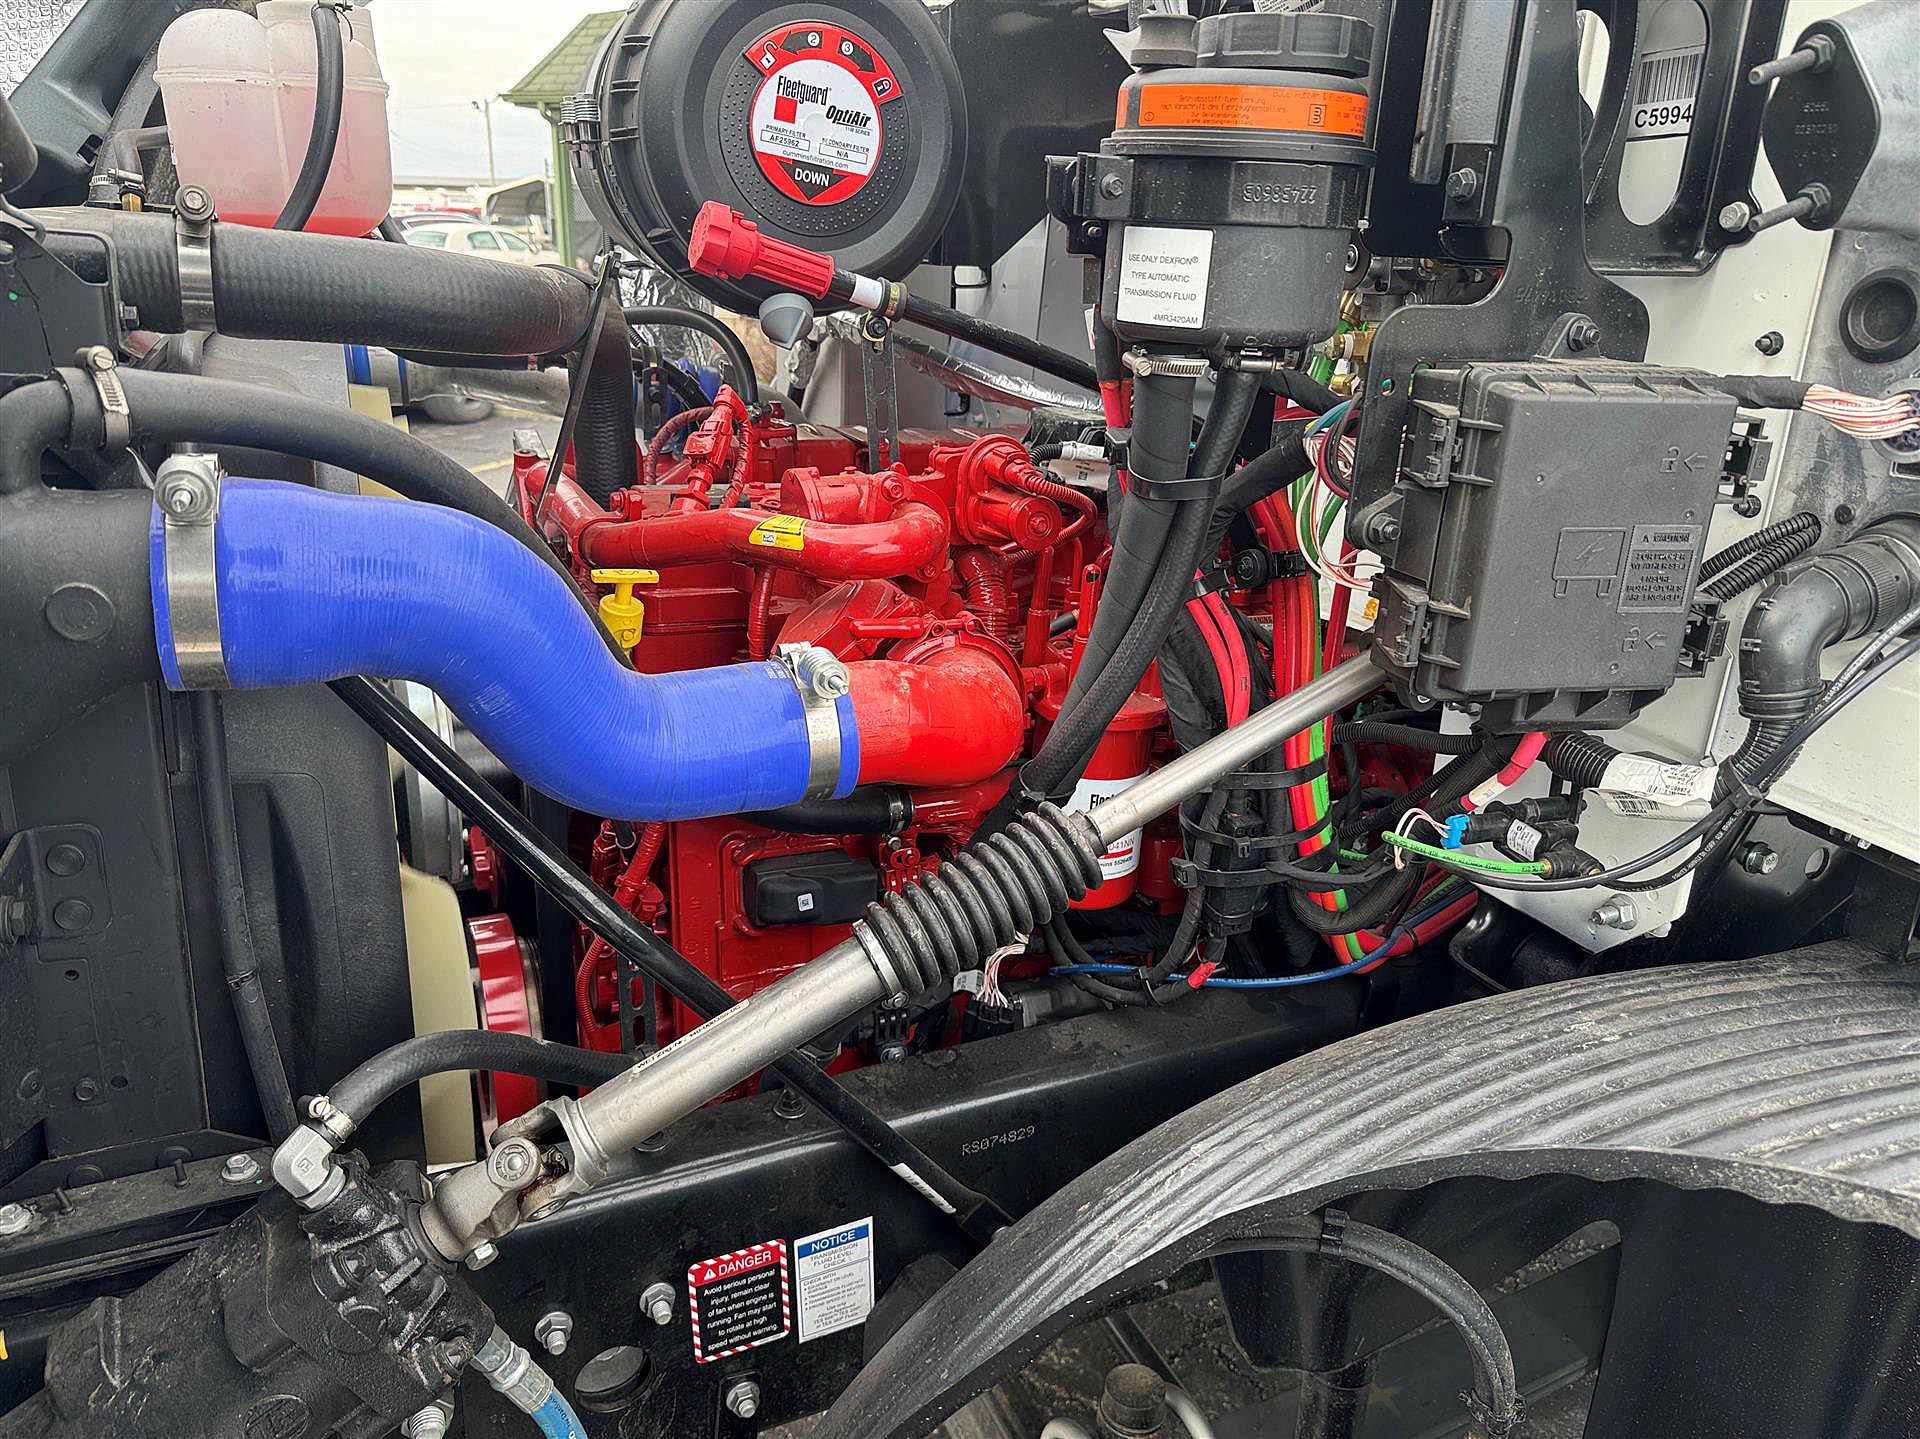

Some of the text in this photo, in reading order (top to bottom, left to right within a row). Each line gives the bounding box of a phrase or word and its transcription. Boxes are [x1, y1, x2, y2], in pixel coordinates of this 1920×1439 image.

[810, 34, 817, 44] 2
[844, 43, 851, 53] 3
[825, 105, 871, 127] OptiAir
[1634, 104, 1693, 128] C5994
[766, 124, 806, 138] PRIMARY FILTER
[822, 138, 869, 153] SECONDARY FILTER
[837, 150, 849, 158] N/A
[782, 150, 849, 169] cumminsfiltration.com
[795, 168, 830, 187] DOWN
[1128, 254, 1140, 262] USE
[1141, 254, 1158, 263] ONLY
[1131, 271, 1190, 283] TYPE AUTOMATIC
[1124, 287, 1197, 301] TRANSMISSION FLUID
[811, 1230, 855, 1253] NOTICE
[811, 1242, 858, 1262] TRANSMISSION
[814, 1250, 853, 1267] FLUID LEVEL
[718, 1250, 772, 1277] DANGER
[824, 1259, 846, 1269] CHECK
[704, 1268, 776, 1296] Avoid serious personal
[731, 1287, 753, 1298] remain
[754, 1282, 770, 1292] clear
[708, 1309, 715, 1318] of
[716, 1307, 726, 1315] fan
[727, 1300, 745, 1311] when
[746, 1293, 767, 1305] engine
[734, 1312, 746, 1320] Fan
[747, 1307, 761, 1316] may
[762, 1302, 776, 1311] start
[718, 1329, 725, 1337] to
[726, 1323, 745, 1333] rotate
[754, 1316, 767, 1326] high
[708, 1339, 728, 1351] speed
[729, 1331, 752, 1344] without
